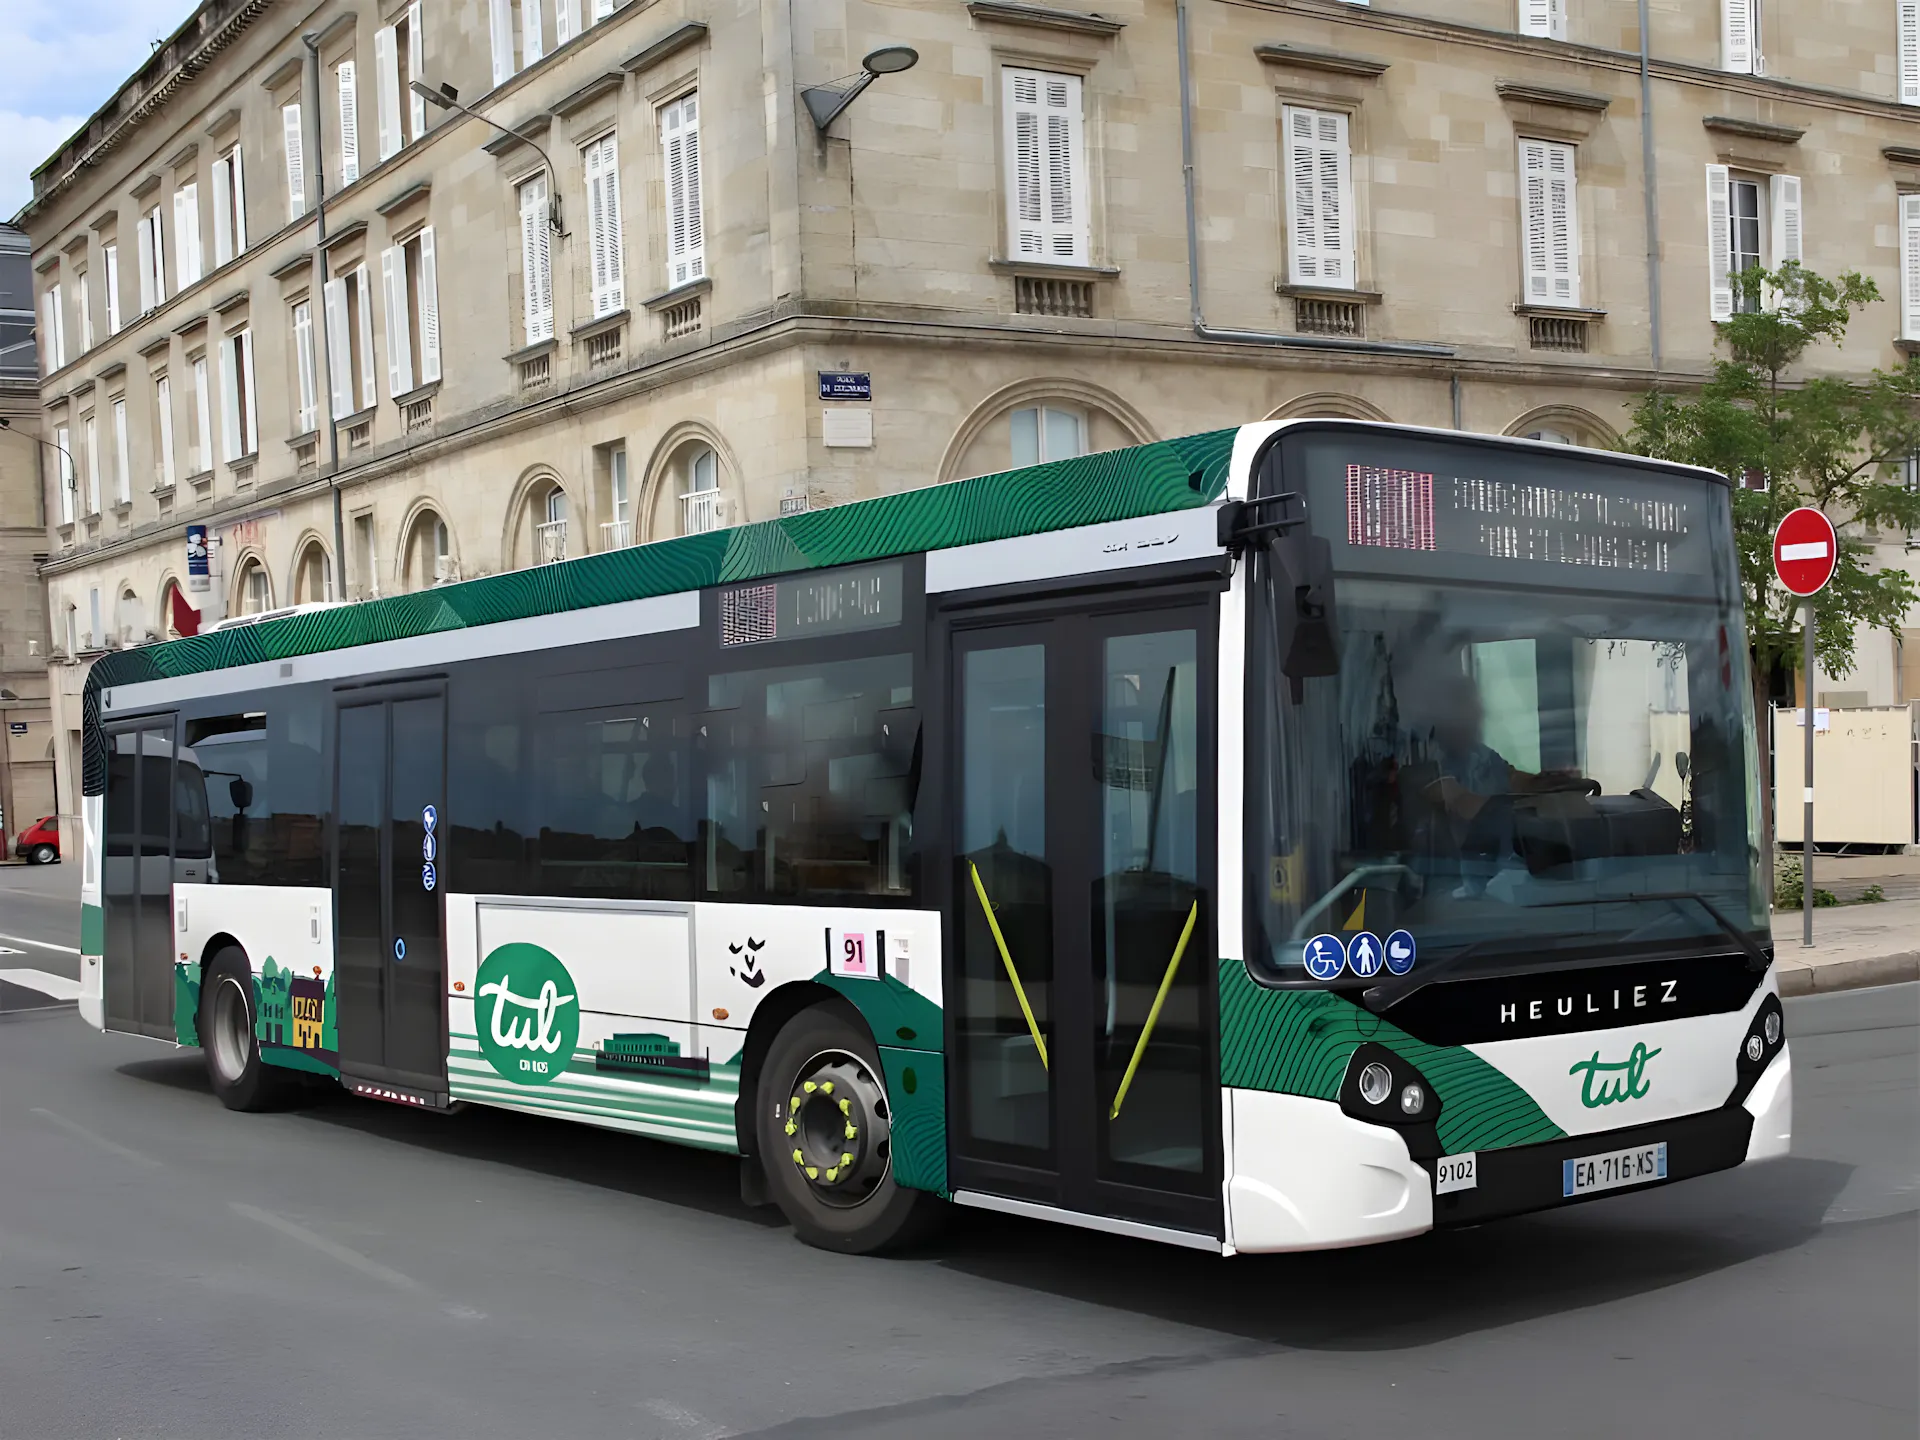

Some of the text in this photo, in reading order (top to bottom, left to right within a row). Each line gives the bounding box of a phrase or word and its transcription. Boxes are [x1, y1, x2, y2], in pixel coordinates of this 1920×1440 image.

[844, 939, 863, 963] 91
[479, 976, 574, 1053] tul
[1500, 979, 1677, 1024] HEULIEZ
[1568, 1041, 1662, 1108] tul
[1438, 1160, 1474, 1184] 9102
